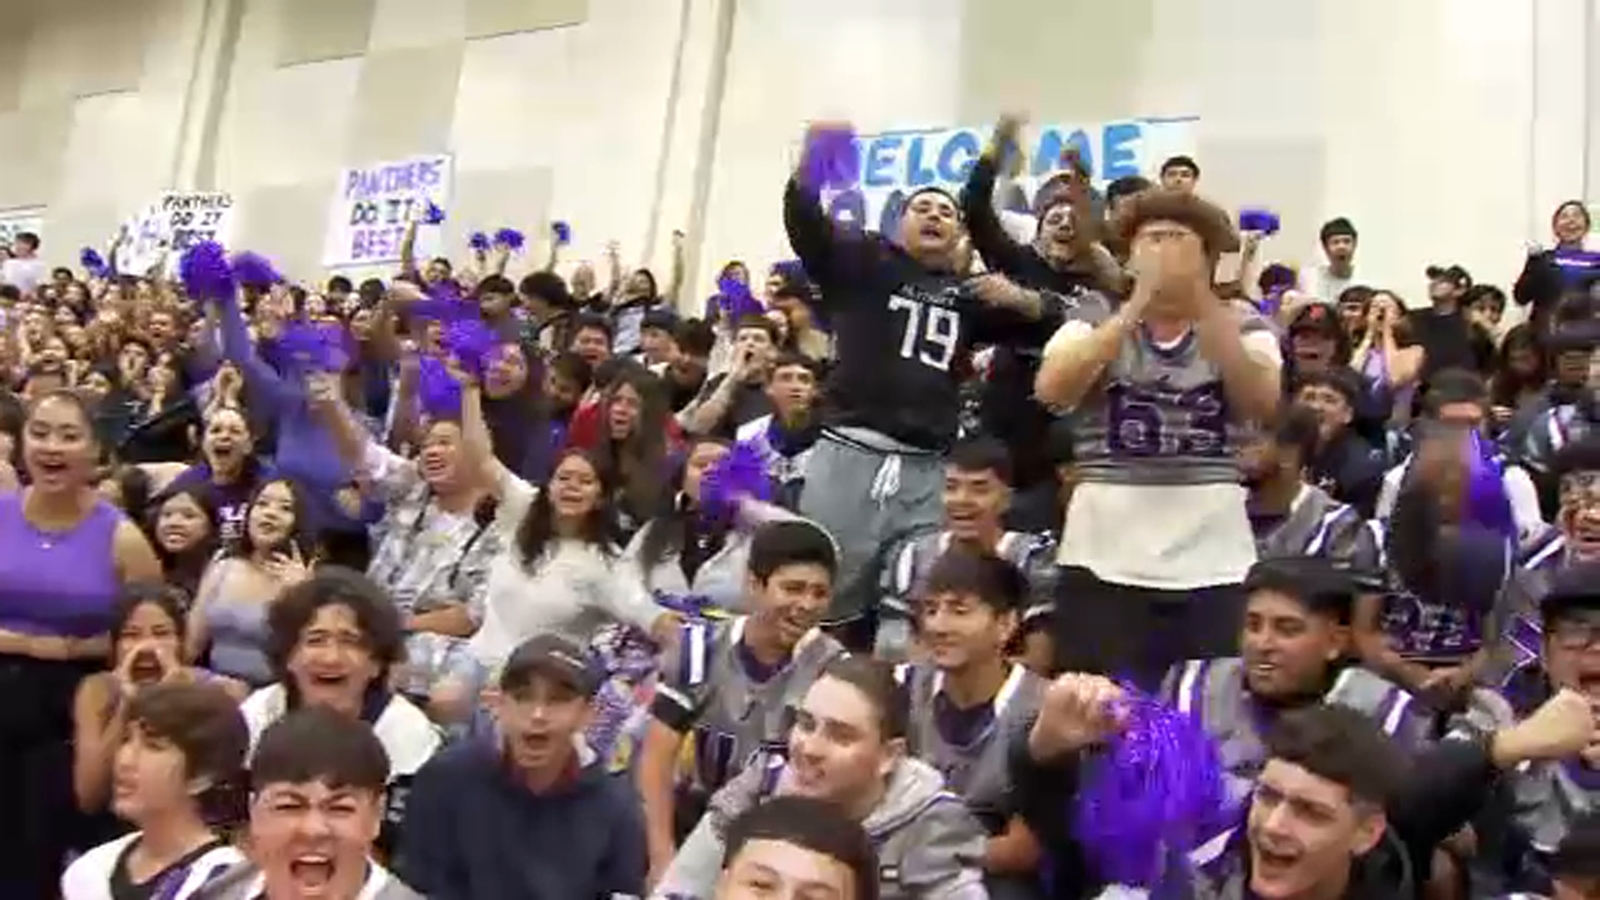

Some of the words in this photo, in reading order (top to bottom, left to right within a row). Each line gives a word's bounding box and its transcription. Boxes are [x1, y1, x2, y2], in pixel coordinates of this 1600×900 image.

[169, 211, 194, 226] DO
[200, 211, 223, 226] IT
[350, 201, 378, 226] DO
[887, 293, 960, 372] 79
